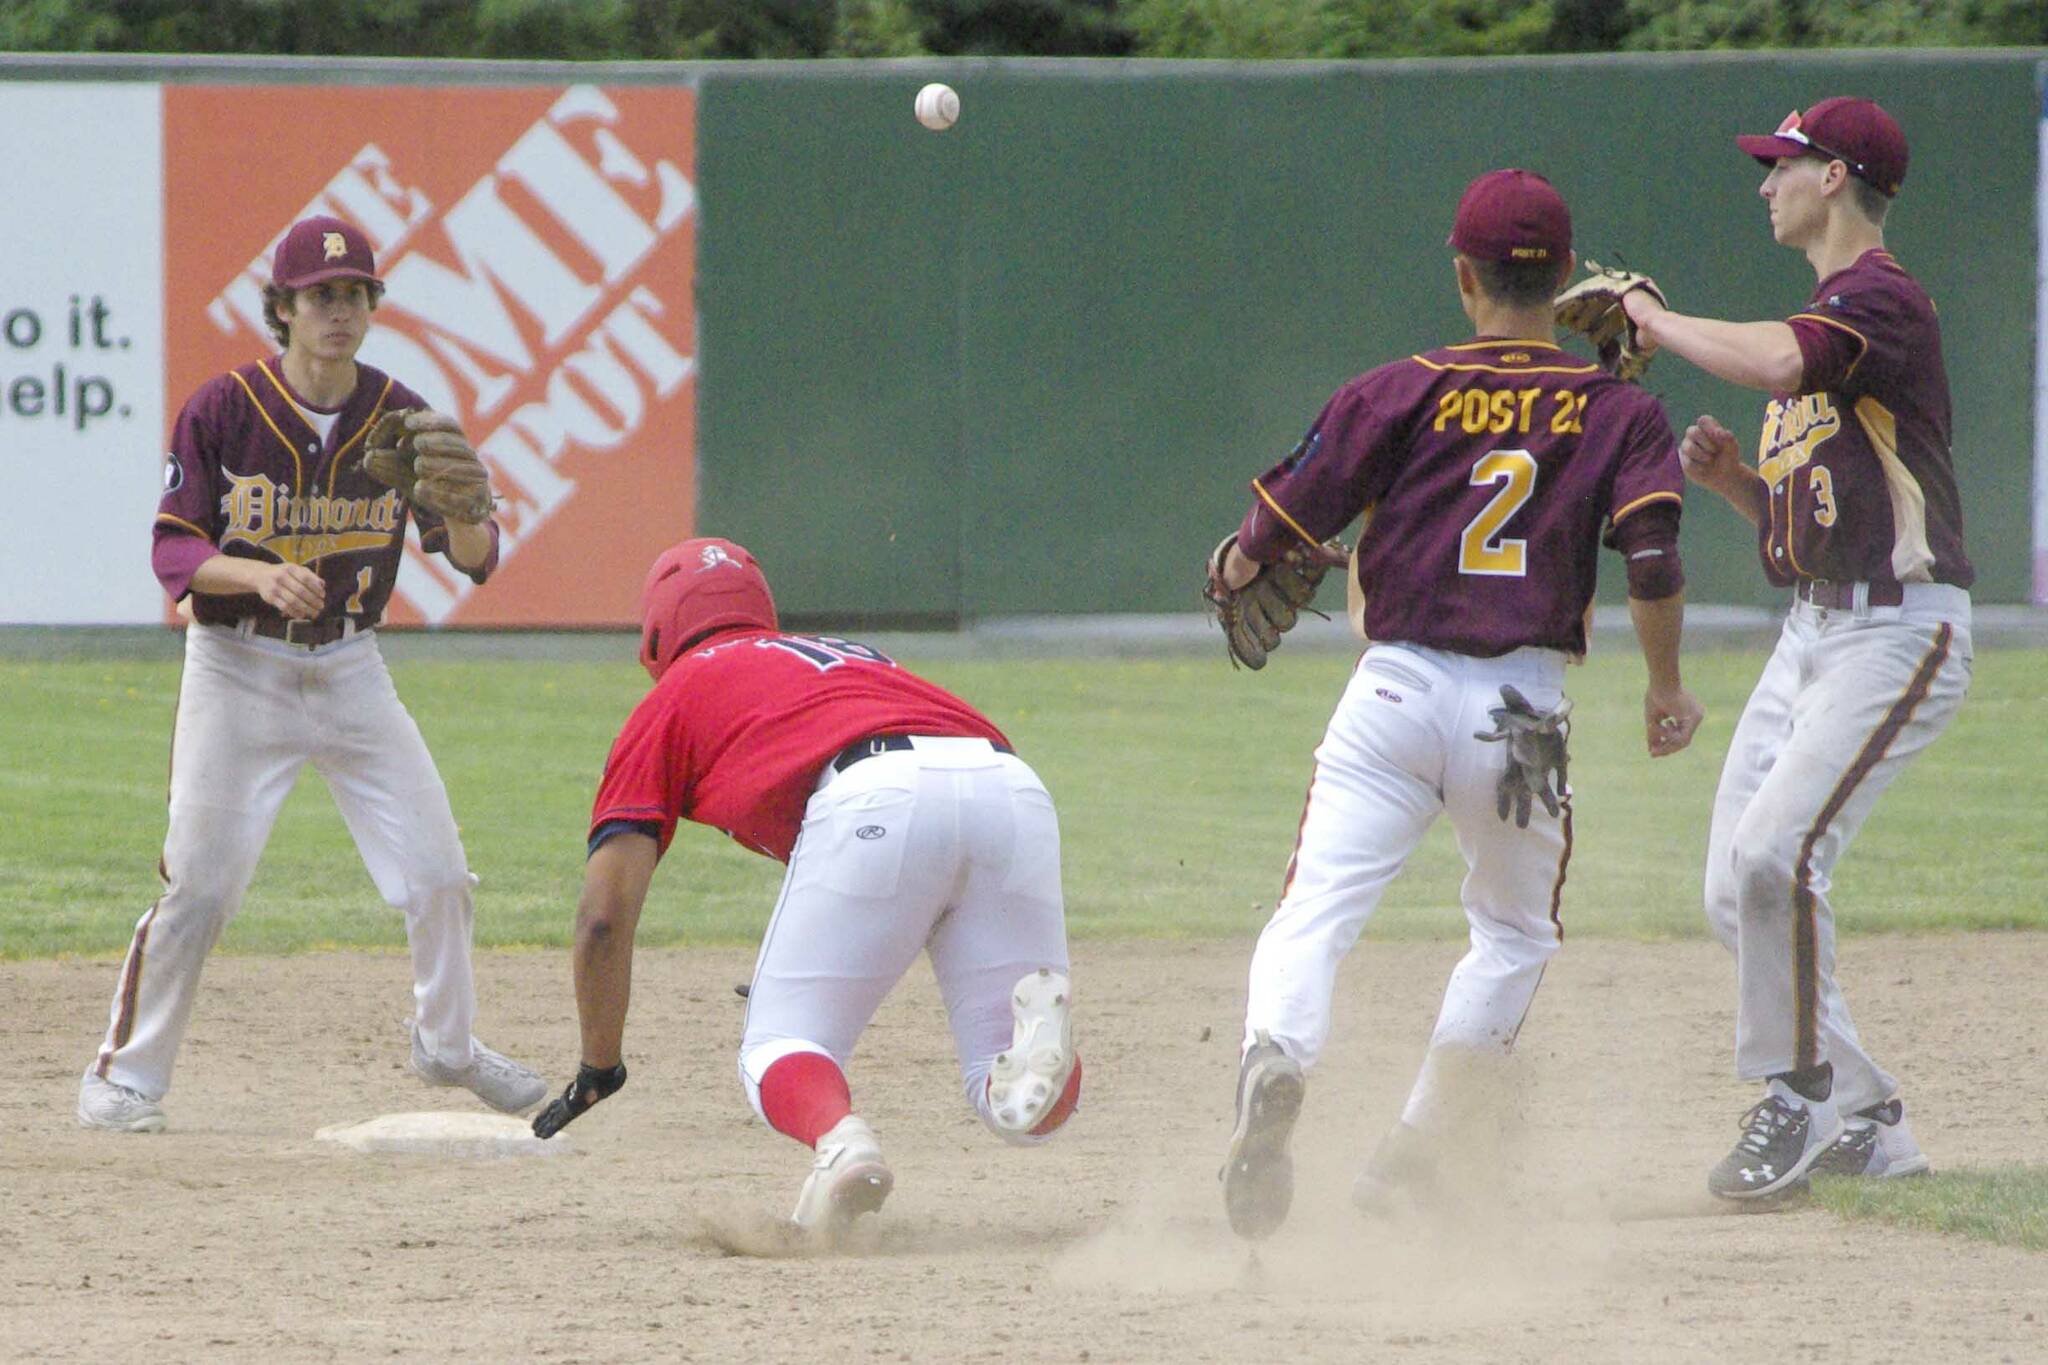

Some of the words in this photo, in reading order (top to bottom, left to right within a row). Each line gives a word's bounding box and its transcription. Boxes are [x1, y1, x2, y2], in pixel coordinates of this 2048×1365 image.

[206, 142, 433, 355] TE
[69, 293, 132, 349] it.
[0, 361, 132, 431] elp.
[1433, 387, 1542, 434] POST
[1551, 389, 1588, 434] 21
[1458, 449, 1538, 576] 2
[1809, 465, 1837, 527] 3
[345, 566, 372, 613] 1
